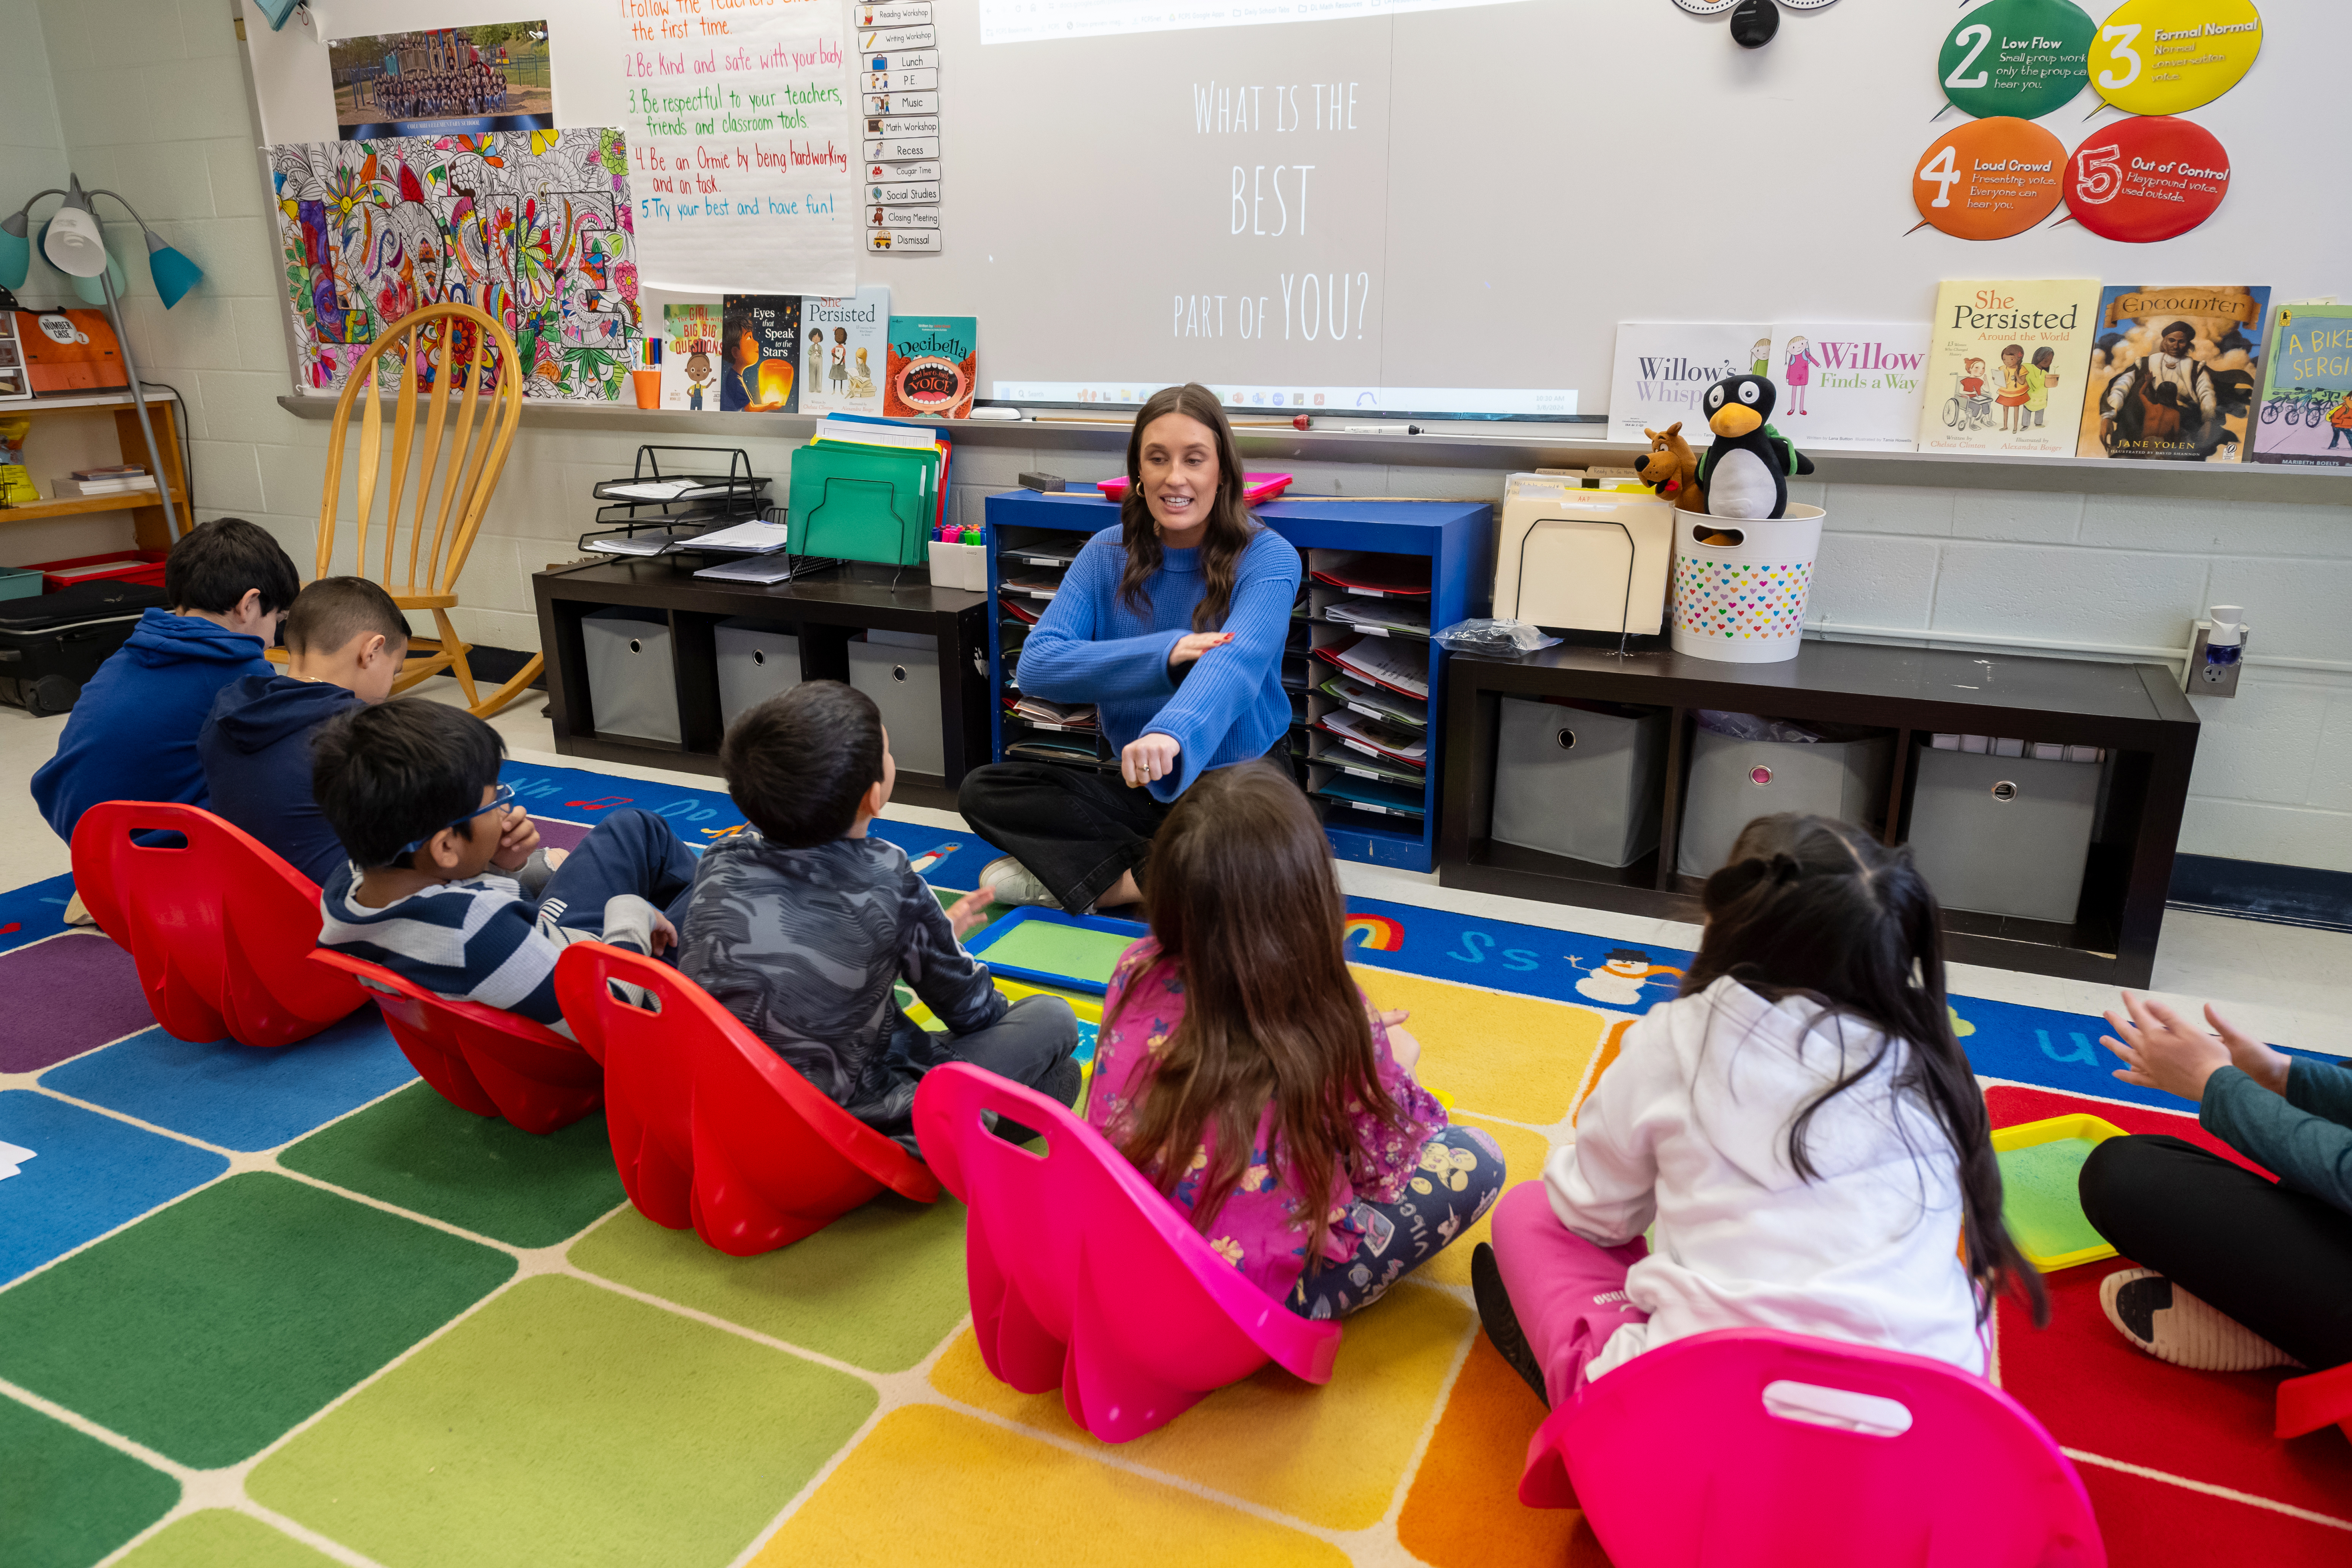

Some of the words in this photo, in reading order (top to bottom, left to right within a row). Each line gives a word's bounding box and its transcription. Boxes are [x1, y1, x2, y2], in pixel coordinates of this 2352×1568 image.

[880, 10, 901, 19] Reading
[903, 8, 928, 18] Workshop
[906, 31, 931, 40] Workshop
[2154, 24, 2202, 42] Formal
[2205, 17, 2259, 36] Normal
[2001, 37, 2029, 49] Low
[2031, 36, 2062, 49] Flow
[2154, 42, 2196, 55] Normal
[694, 49, 715, 74] and
[726, 46, 752, 71] safe
[760, 42, 788, 70] with
[902, 55, 923, 66] Lunch
[1944, 24, 1992, 88] 2
[1999, 52, 2025, 62] Small
[2026, 55, 2057, 65] group
[2060, 54, 2086, 63] work
[2098, 23, 2142, 89] 3
[2152, 54, 2226, 69] conversation
[1996, 66, 2018, 79] only
[2021, 66, 2039, 75] the
[2041, 69, 2071, 79] group
[904, 75, 917, 85] P.E.
[1994, 79, 2020, 88] hear
[2023, 82, 2042, 92] you.
[642, 88, 659, 113] Be
[663, 83, 722, 117] respectful
[729, 90, 741, 108] to
[749, 92, 776, 114] your
[785, 82, 842, 106] teachers,
[903, 98, 923, 107] Music
[886, 122, 902, 131] Math
[904, 121, 936, 133] Workshop
[897, 146, 923, 155] Recess
[896, 168, 917, 176] Cougar
[1974, 158, 2006, 171] Loud
[2009, 159, 2052, 172] Crowd
[2131, 157, 2156, 171] Out
[2158, 162, 2177, 173] of
[2178, 163, 2229, 181] Control
[1920, 146, 1961, 207] 4
[1972, 173, 2025, 187] Presenting
[2029, 177, 2056, 185] voice.
[2077, 144, 2122, 204] 5
[2126, 172, 2188, 189] Playground
[2189, 182, 2218, 193] voice.
[887, 188, 908, 200] Social
[910, 188, 937, 199] Studies
[1970, 186, 2017, 199] Everyone
[2122, 188, 2145, 197] used
[2146, 190, 2185, 202] outside.
[1231, 165, 1315, 236] BEST
[1967, 199, 1992, 208] hear
[1995, 202, 2014, 212] you.
[888, 212, 911, 224] Closing
[914, 213, 937, 224] Meeting
[898, 234, 929, 244] Dismissal
[820, 297, 841, 307] She
[1974, 289, 2015, 309] She
[809, 303, 875, 322] Persisted
[1280, 272, 1369, 341] YOU?
[689, 307, 709, 321] GIRL
[754, 308, 775, 320] Eyes
[1951, 303, 2078, 330] Persisted
[42, 321, 73, 330] NUMBER
[702, 324, 717, 338] BIG
[53, 330, 71, 338] CASE
[78, 333, 85, 343] 2
[765, 328, 794, 341] Speak
[1977, 332, 2016, 341] Around
[2020, 332, 2036, 341] the
[2040, 332, 2070, 341] World
[675, 338, 722, 356] QUESTIONS
[897, 332, 967, 361] Decibella
[2289, 334, 2303, 355] A
[2311, 329, 2352, 352] BIKE
[763, 347, 788, 357] Stars
[1818, 342, 1926, 370] Willow
[912, 371, 922, 380] and
[1638, 357, 1736, 381] Willow's
[2293, 357, 2352, 380] SERGI
[908, 377, 952, 393] VOICE
[1819, 373, 1867, 388] Finds
[1871, 379, 1881, 389] a
[1884, 373, 1919, 394] Way
[1635, 381, 1703, 410] Whisp
